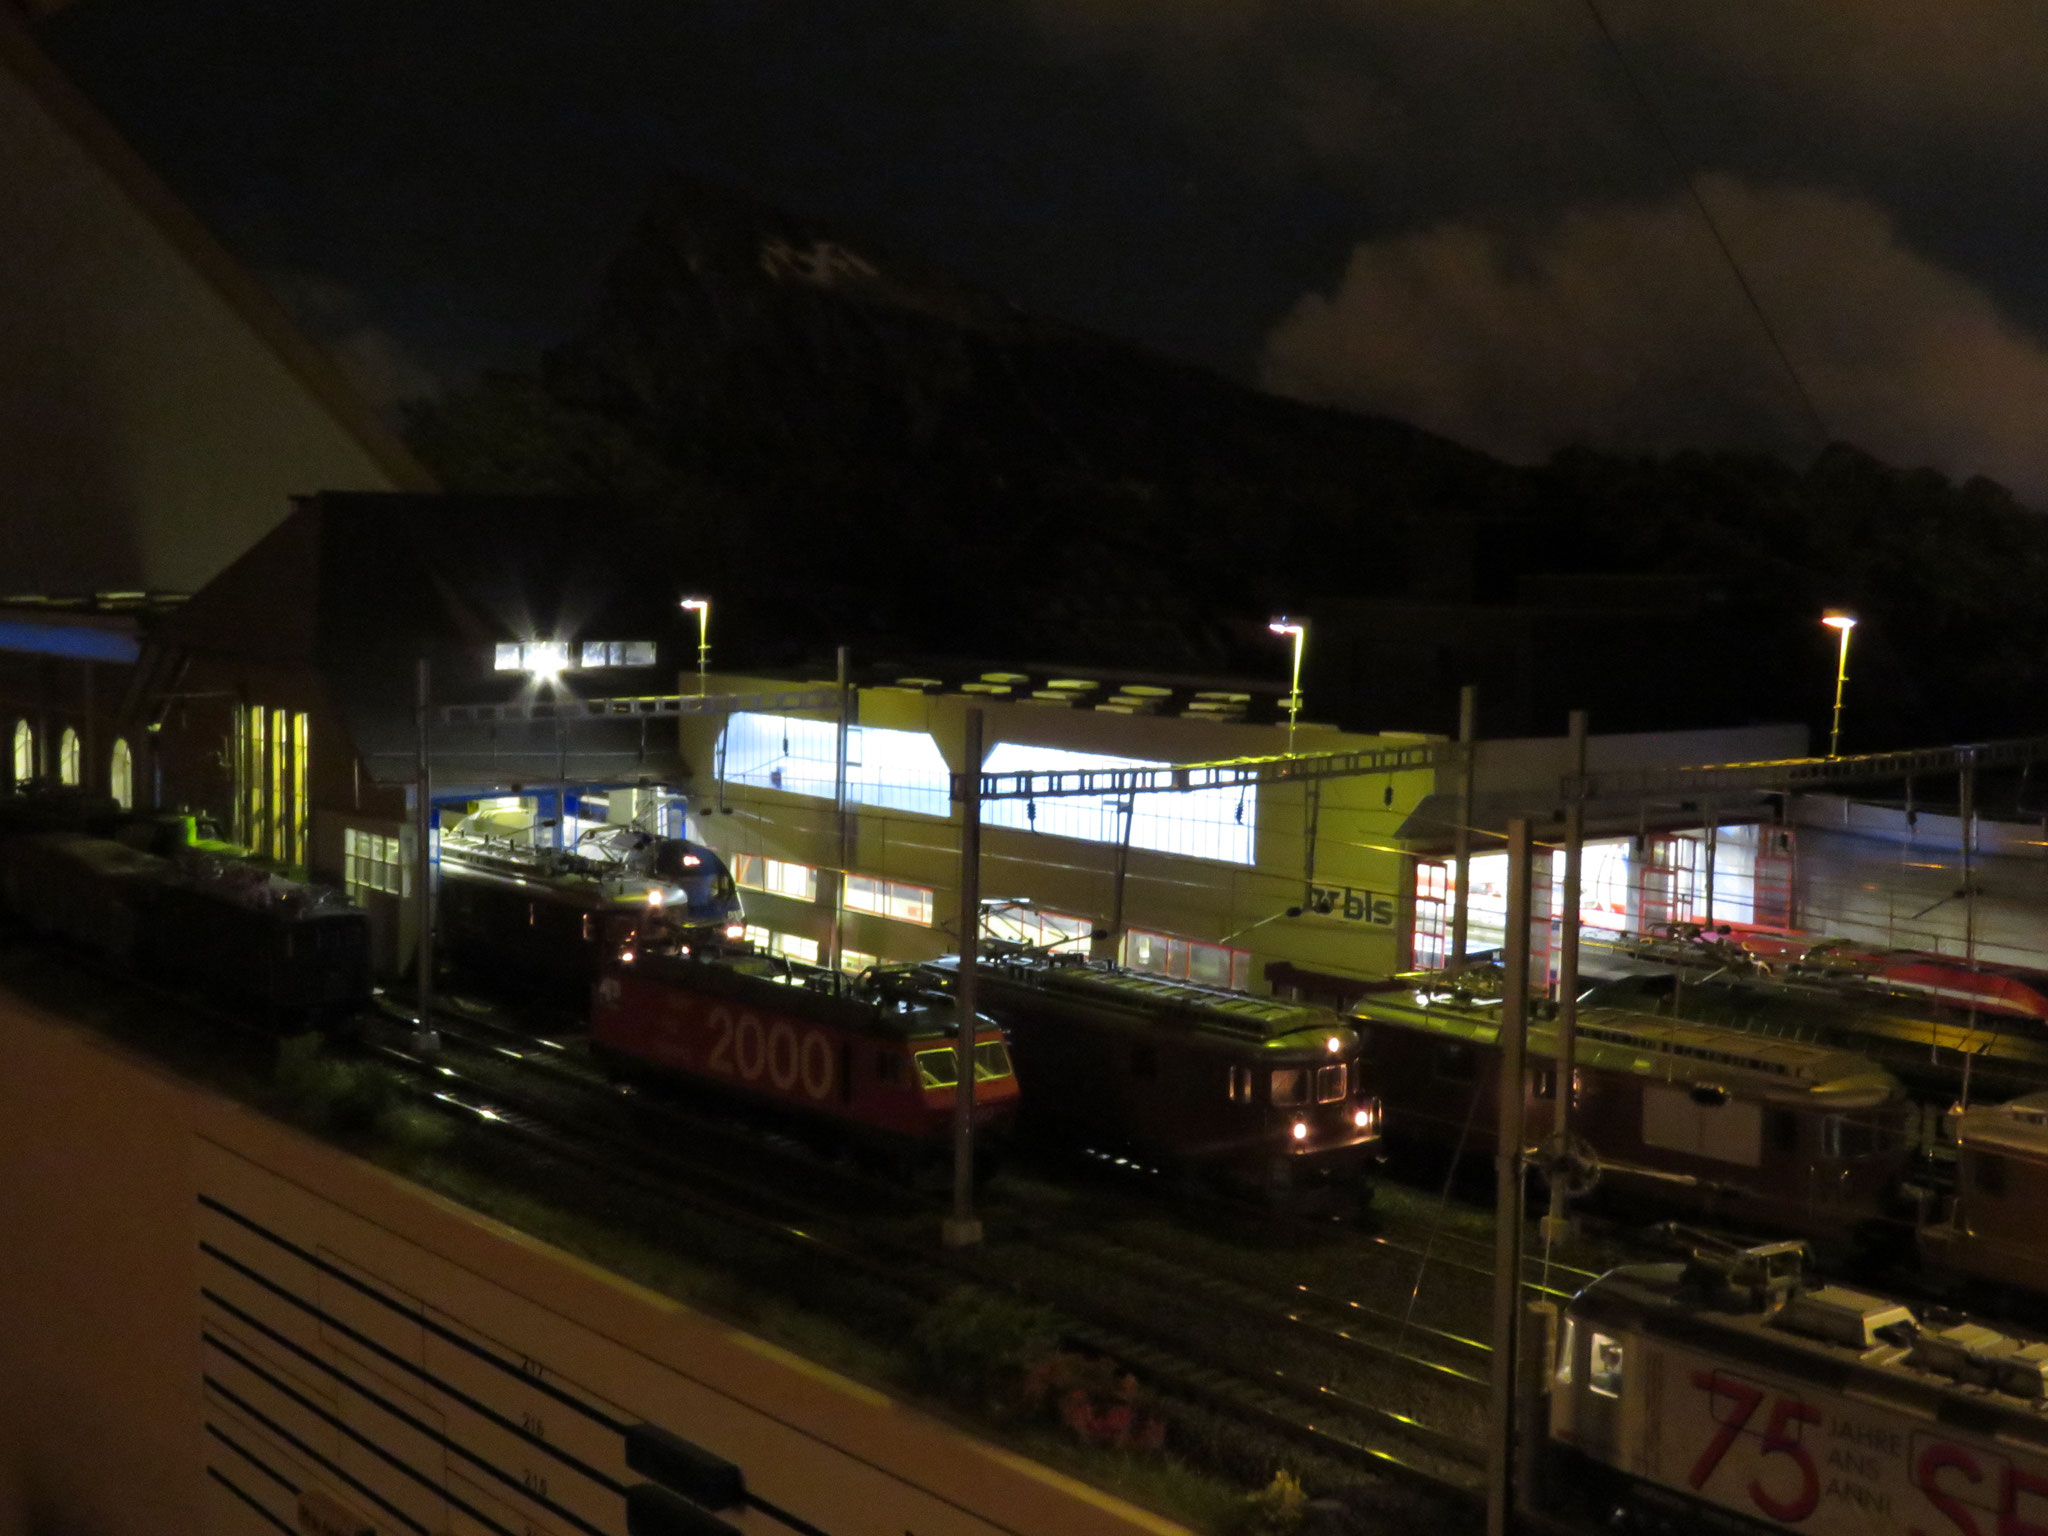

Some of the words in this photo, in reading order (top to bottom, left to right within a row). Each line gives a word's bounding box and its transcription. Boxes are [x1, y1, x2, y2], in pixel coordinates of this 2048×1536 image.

[1343, 887, 1393, 925] bls
[708, 1005, 835, 1099] 2000
[1688, 1370, 1824, 1524] 75
[1827, 1415, 1902, 1457] JAHRE
[1827, 1447, 1881, 1481] ANS
[1825, 1477, 1894, 1516] ANNI
